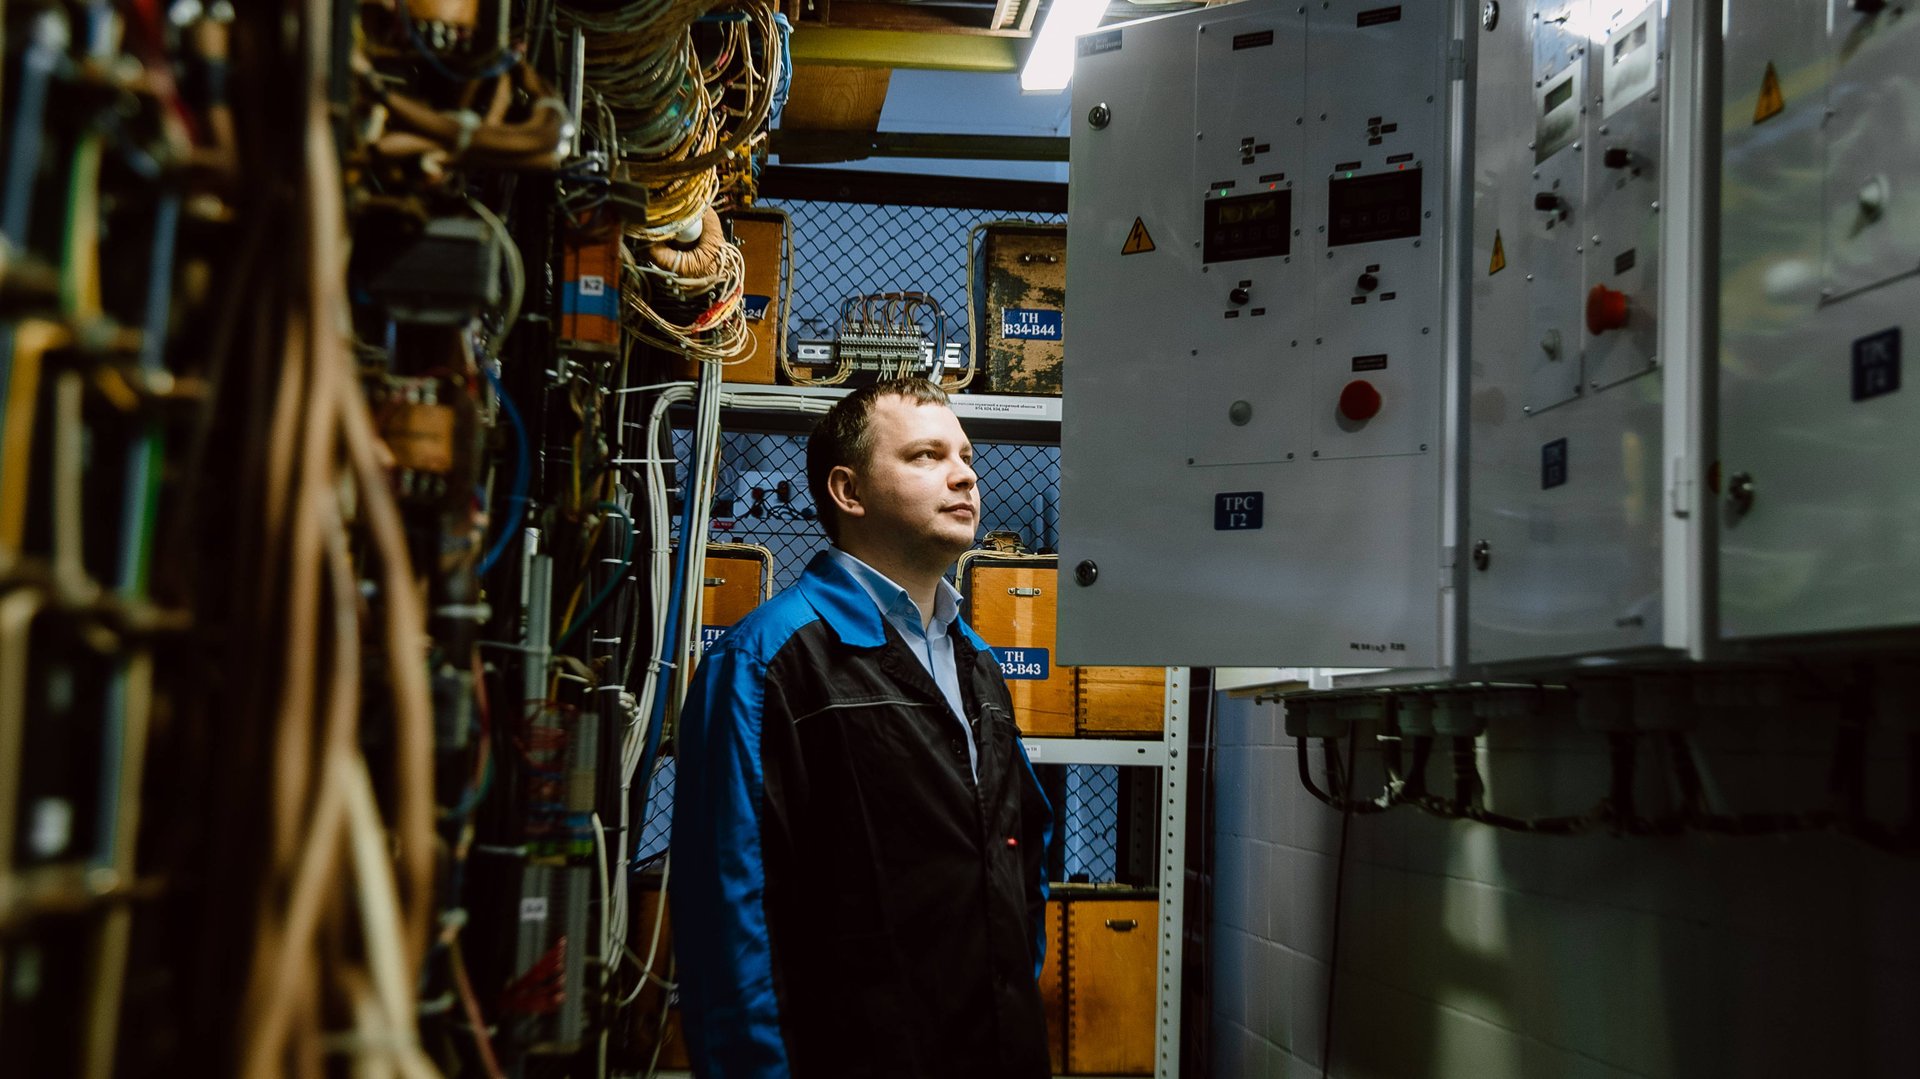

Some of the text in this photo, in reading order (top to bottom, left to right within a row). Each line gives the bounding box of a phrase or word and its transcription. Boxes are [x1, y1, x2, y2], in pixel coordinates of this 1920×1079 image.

[1019, 312, 1039, 323] ТН
[1005, 323, 1055, 336] В34-В44
[1222, 496, 1254, 510] ТРС
[1229, 513, 1247, 527] Г2
[1004, 651, 1024, 662] ТН
[1000, 662, 1041, 675] 33-В43
